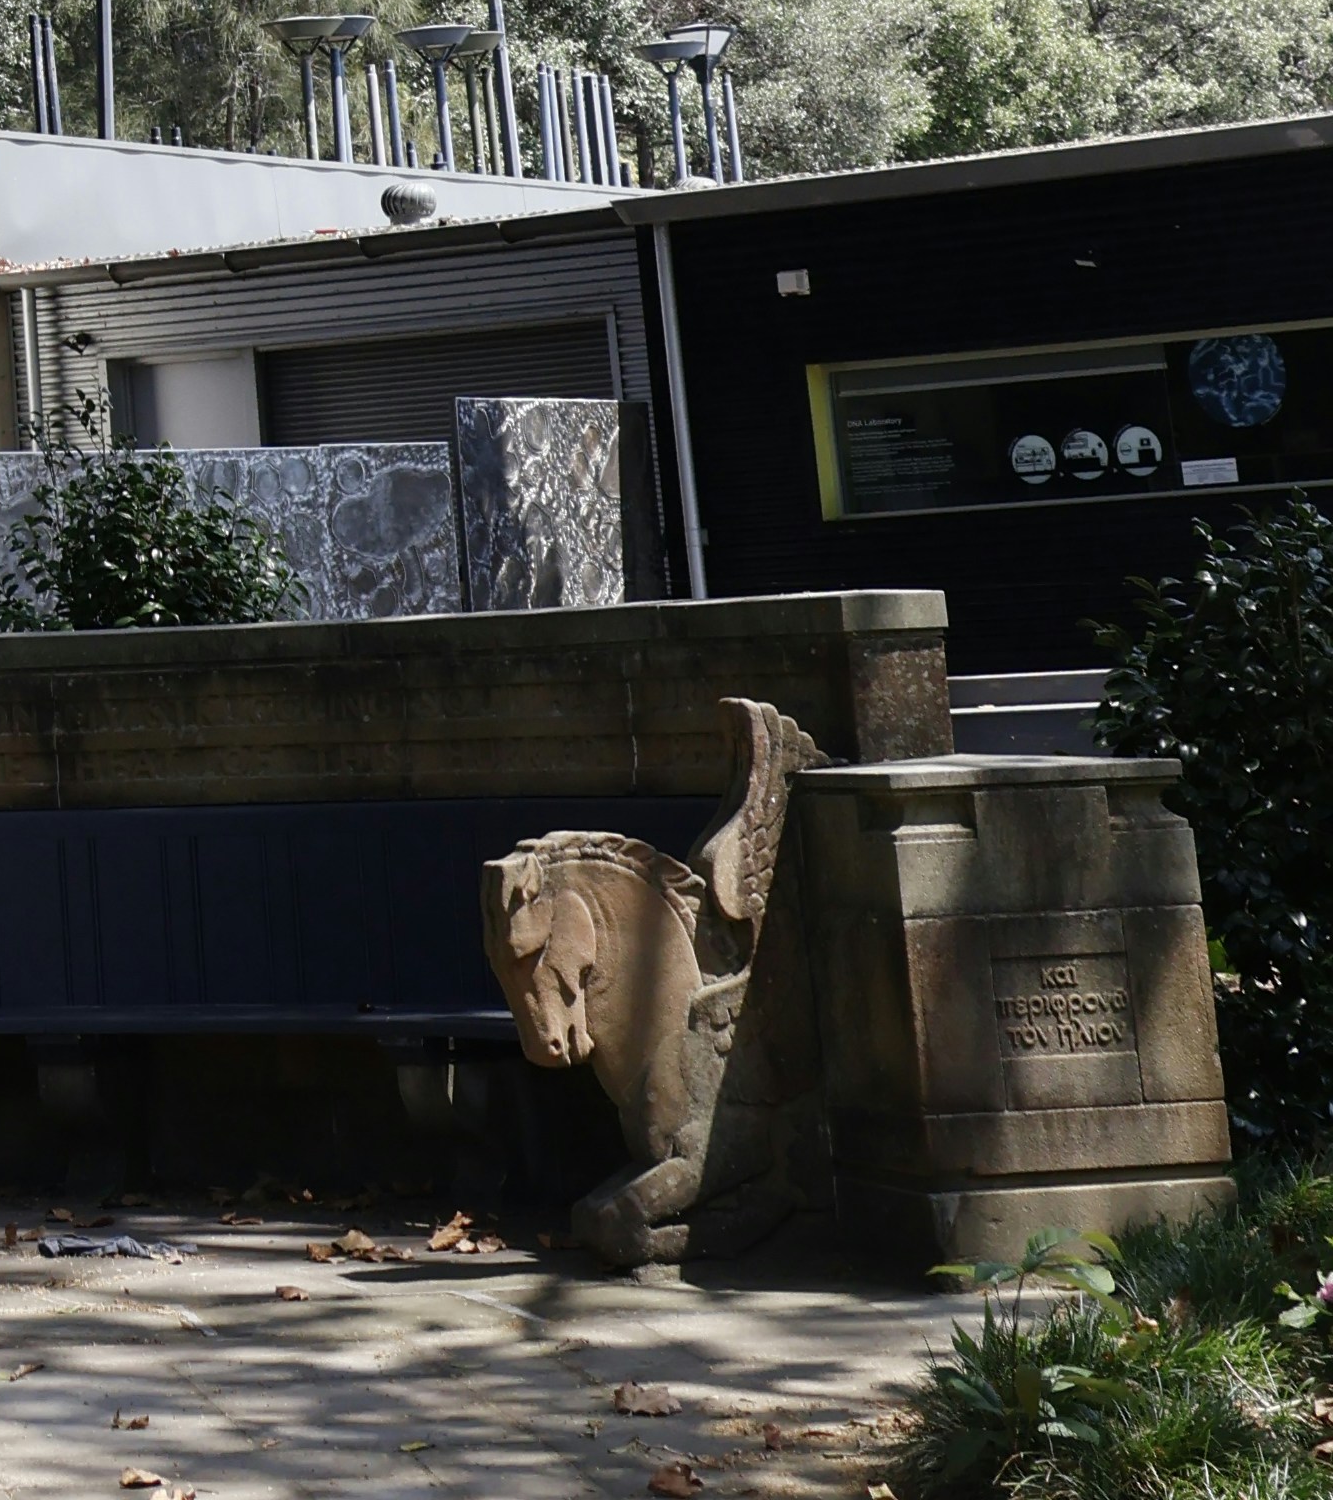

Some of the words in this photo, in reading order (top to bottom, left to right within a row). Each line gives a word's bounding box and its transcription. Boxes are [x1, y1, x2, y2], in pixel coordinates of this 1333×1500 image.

[847, 419, 863, 428] DNA
[864, 418, 902, 427] Laboratory
[218, 746, 276, 778] OF
